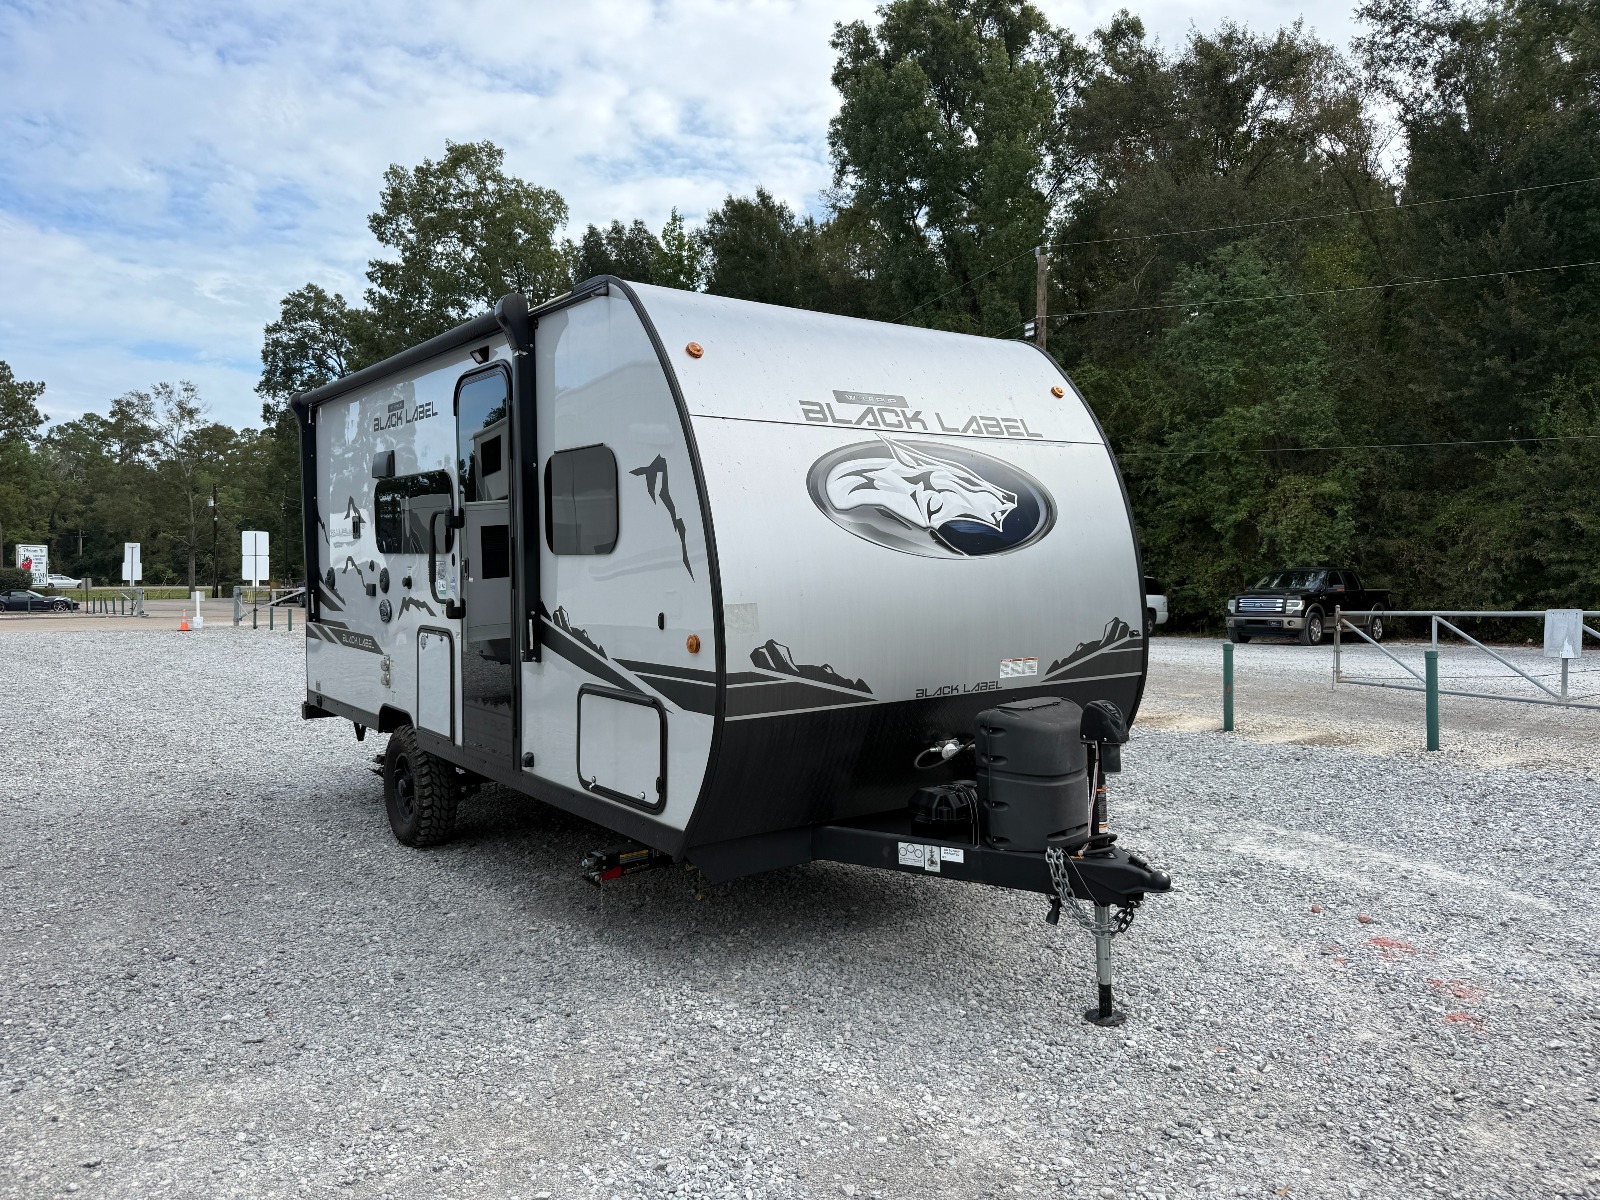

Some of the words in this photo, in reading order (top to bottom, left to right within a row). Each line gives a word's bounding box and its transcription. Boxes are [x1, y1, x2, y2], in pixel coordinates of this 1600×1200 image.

[373, 411, 403, 432] BLACK
[405, 401, 439, 424] LABEL
[798, 400, 929, 430] BLACK
[934, 412, 1044, 438] LABEL
[342, 633, 359, 645] BLACK
[359, 637, 375, 648] LABEL
[915, 685, 960, 699] BLACK
[963, 680, 1003, 693] LABEL
